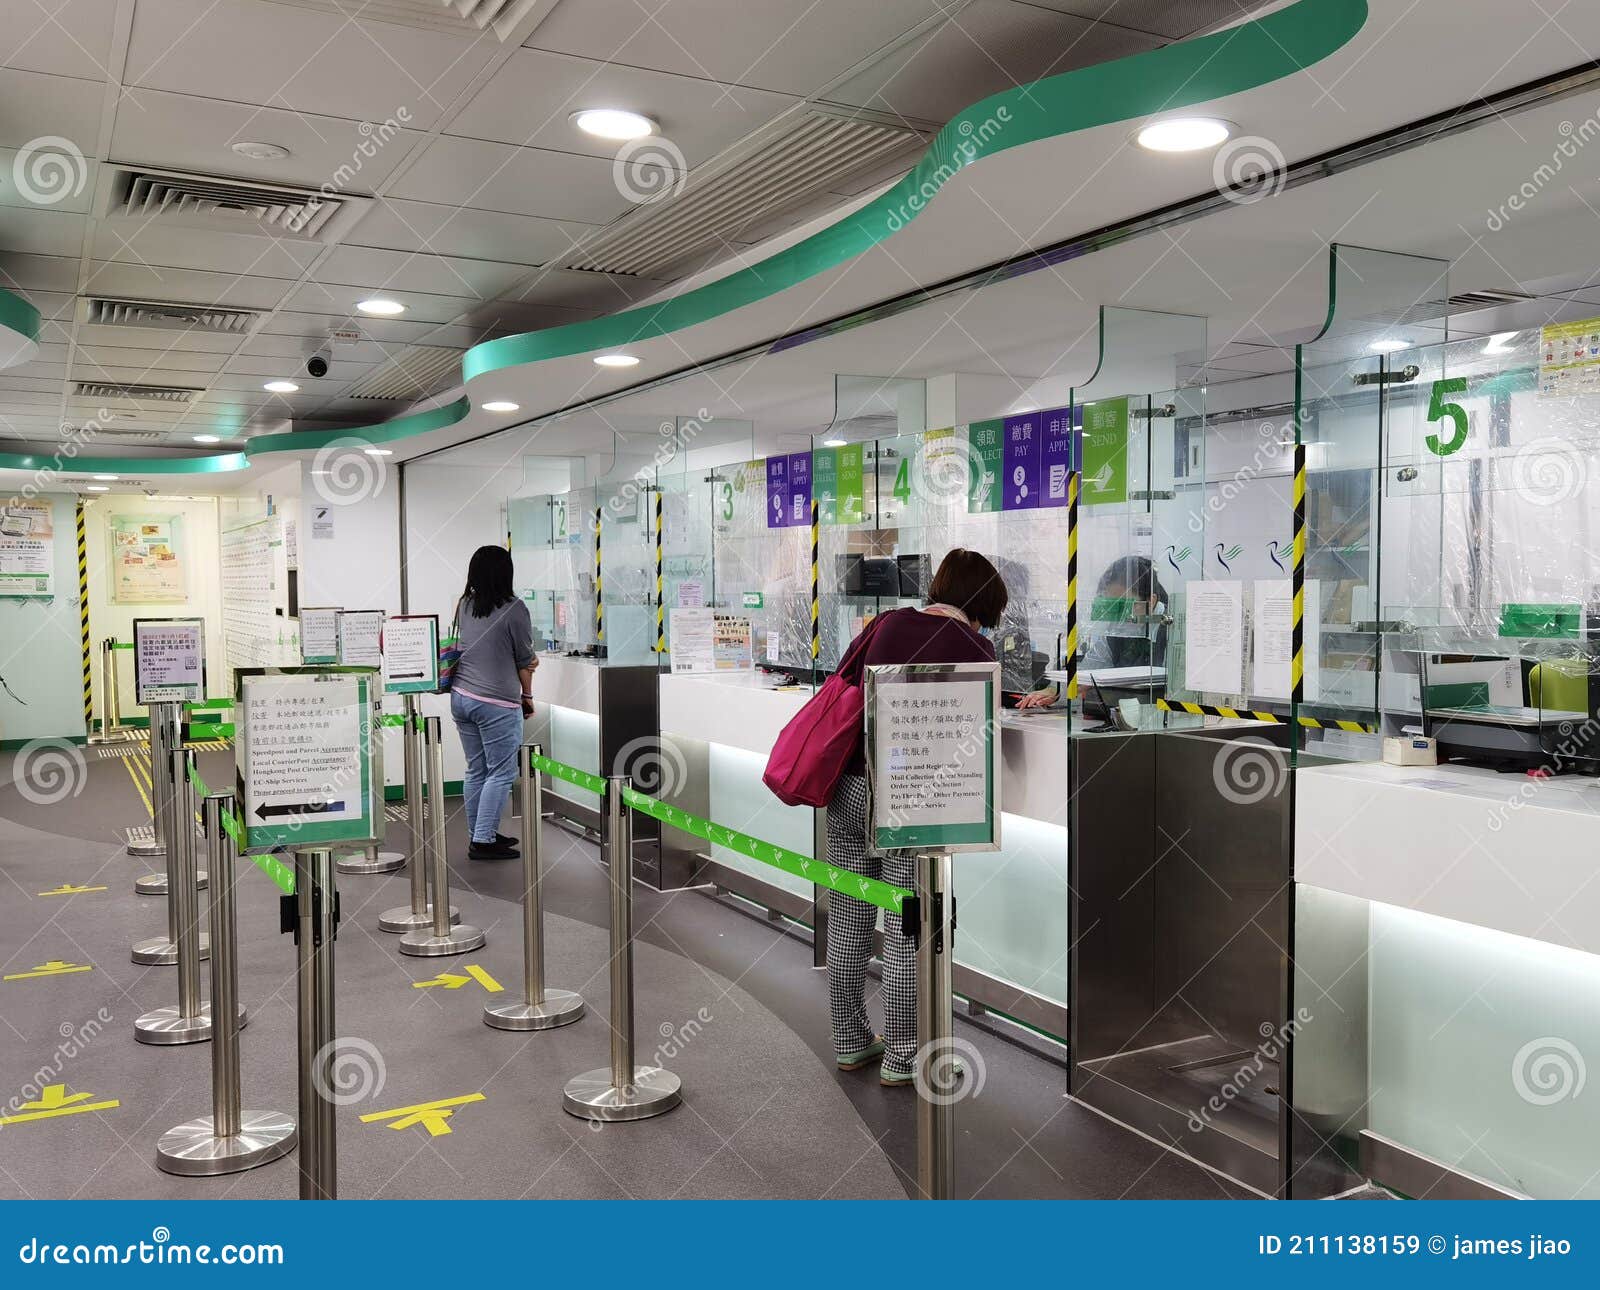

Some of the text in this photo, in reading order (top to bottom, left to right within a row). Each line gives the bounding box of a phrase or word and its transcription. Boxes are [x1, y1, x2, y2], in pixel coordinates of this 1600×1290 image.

[1425, 376, 1469, 456] 5
[1011, 422, 1033, 442] 繳費
[1050, 417, 1070, 435] 申請
[976, 429, 996, 447] 領取
[1048, 439, 1070, 453] APPL
[1092, 432, 1117, 448] SEND
[970, 447, 1003, 463] COLLECT
[1014, 444, 1029, 457] PAY
[793, 459, 807, 473] 申請
[792, 474, 808, 486] APPLY
[893, 457, 911, 506] 4
[723, 483, 734, 521] 3
[559, 507, 565, 536] 2
[311, 757, 346, 765] Acceptance
[891, 764, 912, 772] Stamps
[253, 768, 287, 776] Hongkong
